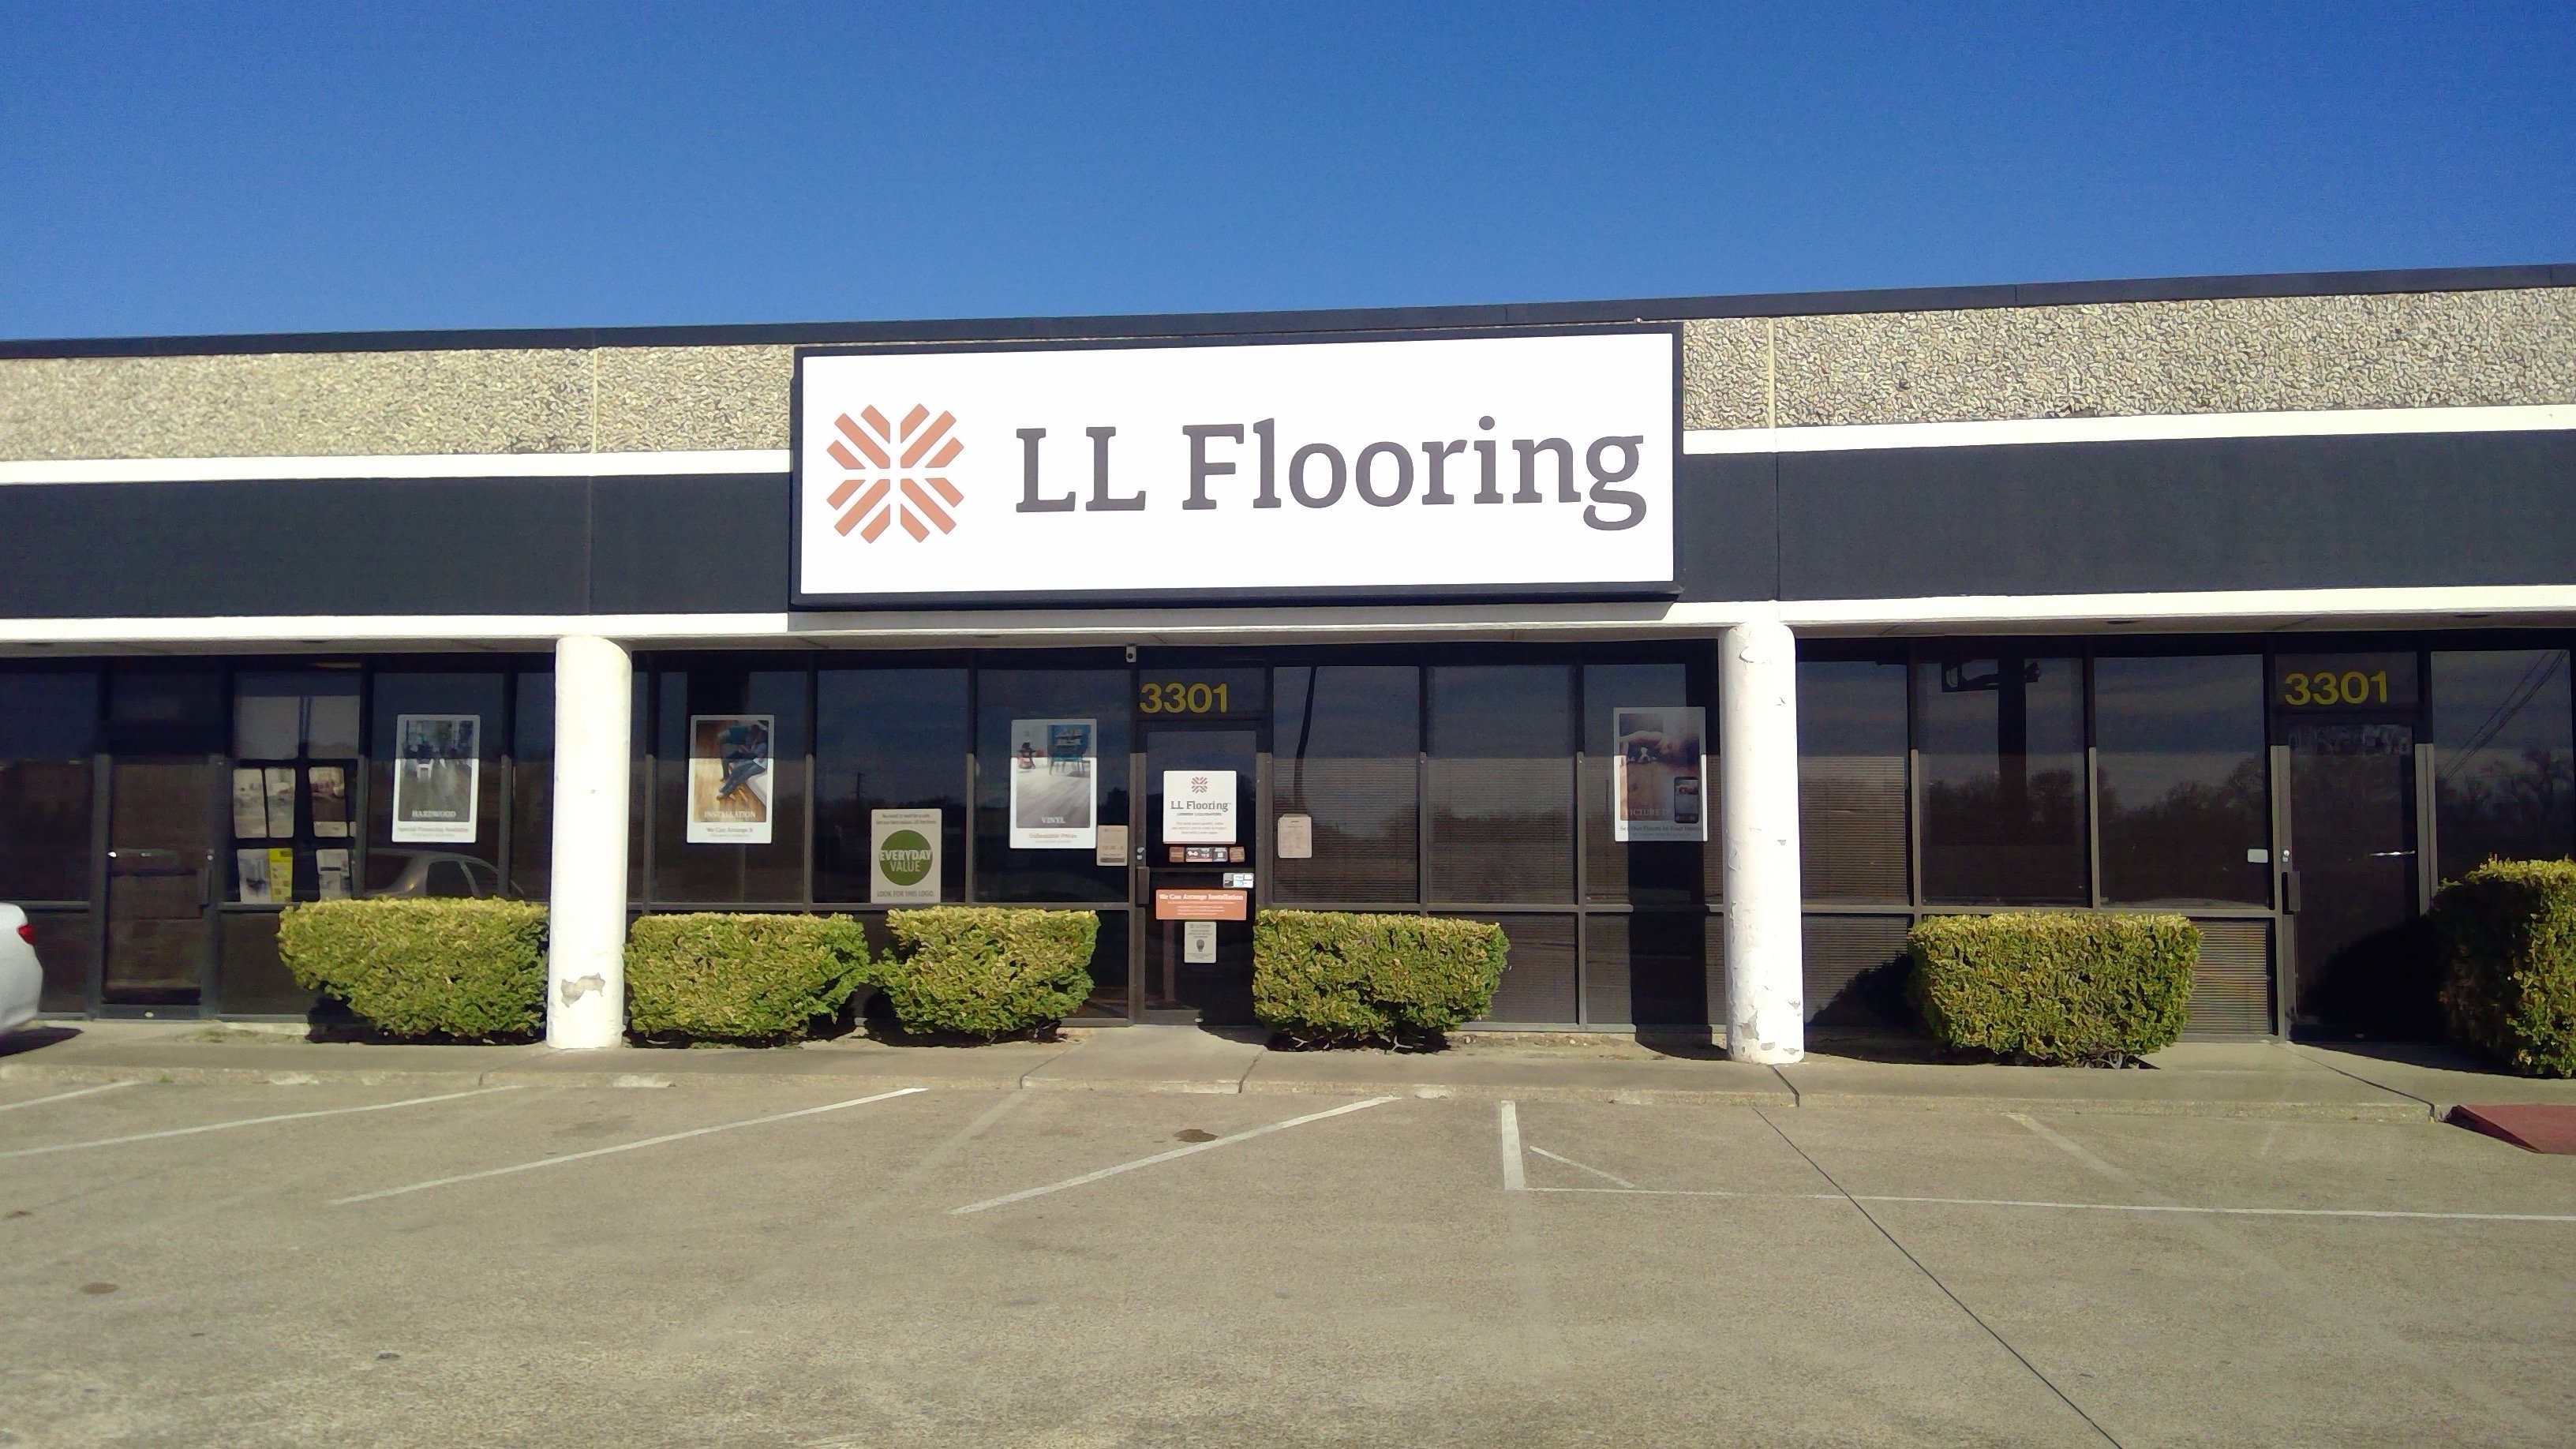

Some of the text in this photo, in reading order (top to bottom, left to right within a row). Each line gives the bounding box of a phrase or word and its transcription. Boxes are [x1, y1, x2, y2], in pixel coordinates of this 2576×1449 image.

[1017, 416, 1646, 530] LL Flooring
[1139, 683, 1227, 713] 3301
[2284, 671, 2387, 706] 3301
[1170, 800, 1229, 812] LL Flooring
[880, 850, 932, 861] EVERYDAY
[889, 860, 921, 872] VALUE
